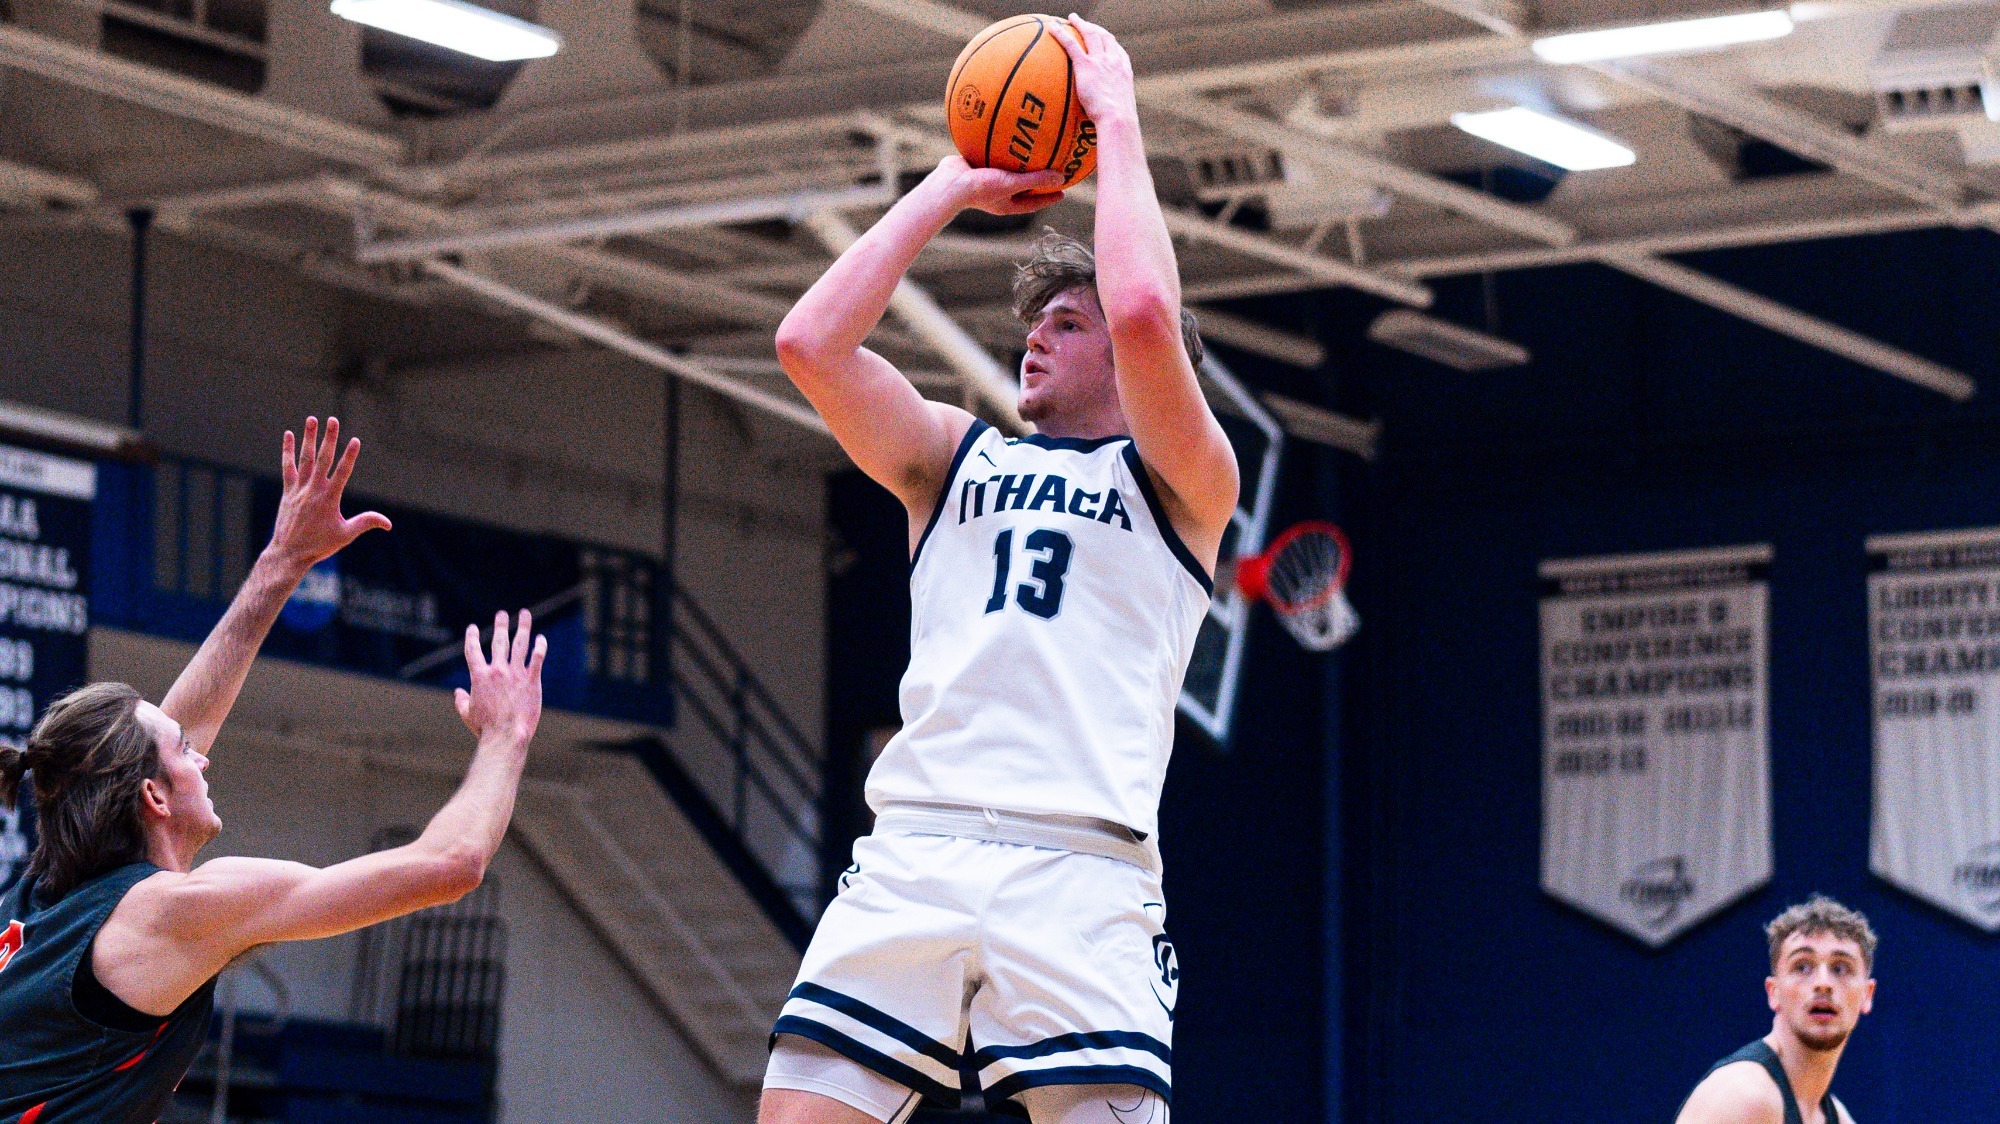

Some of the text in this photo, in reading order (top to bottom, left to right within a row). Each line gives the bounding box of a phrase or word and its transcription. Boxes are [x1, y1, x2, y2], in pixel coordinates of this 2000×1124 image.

[959, 473, 1133, 532] ITHACA
[982, 526, 1077, 623] 13
[1581, 602, 1699, 635] EMPIRE
[1552, 626, 1752, 668] CONFERENCE
[1551, 663, 1752, 702] CHAMPIONS
